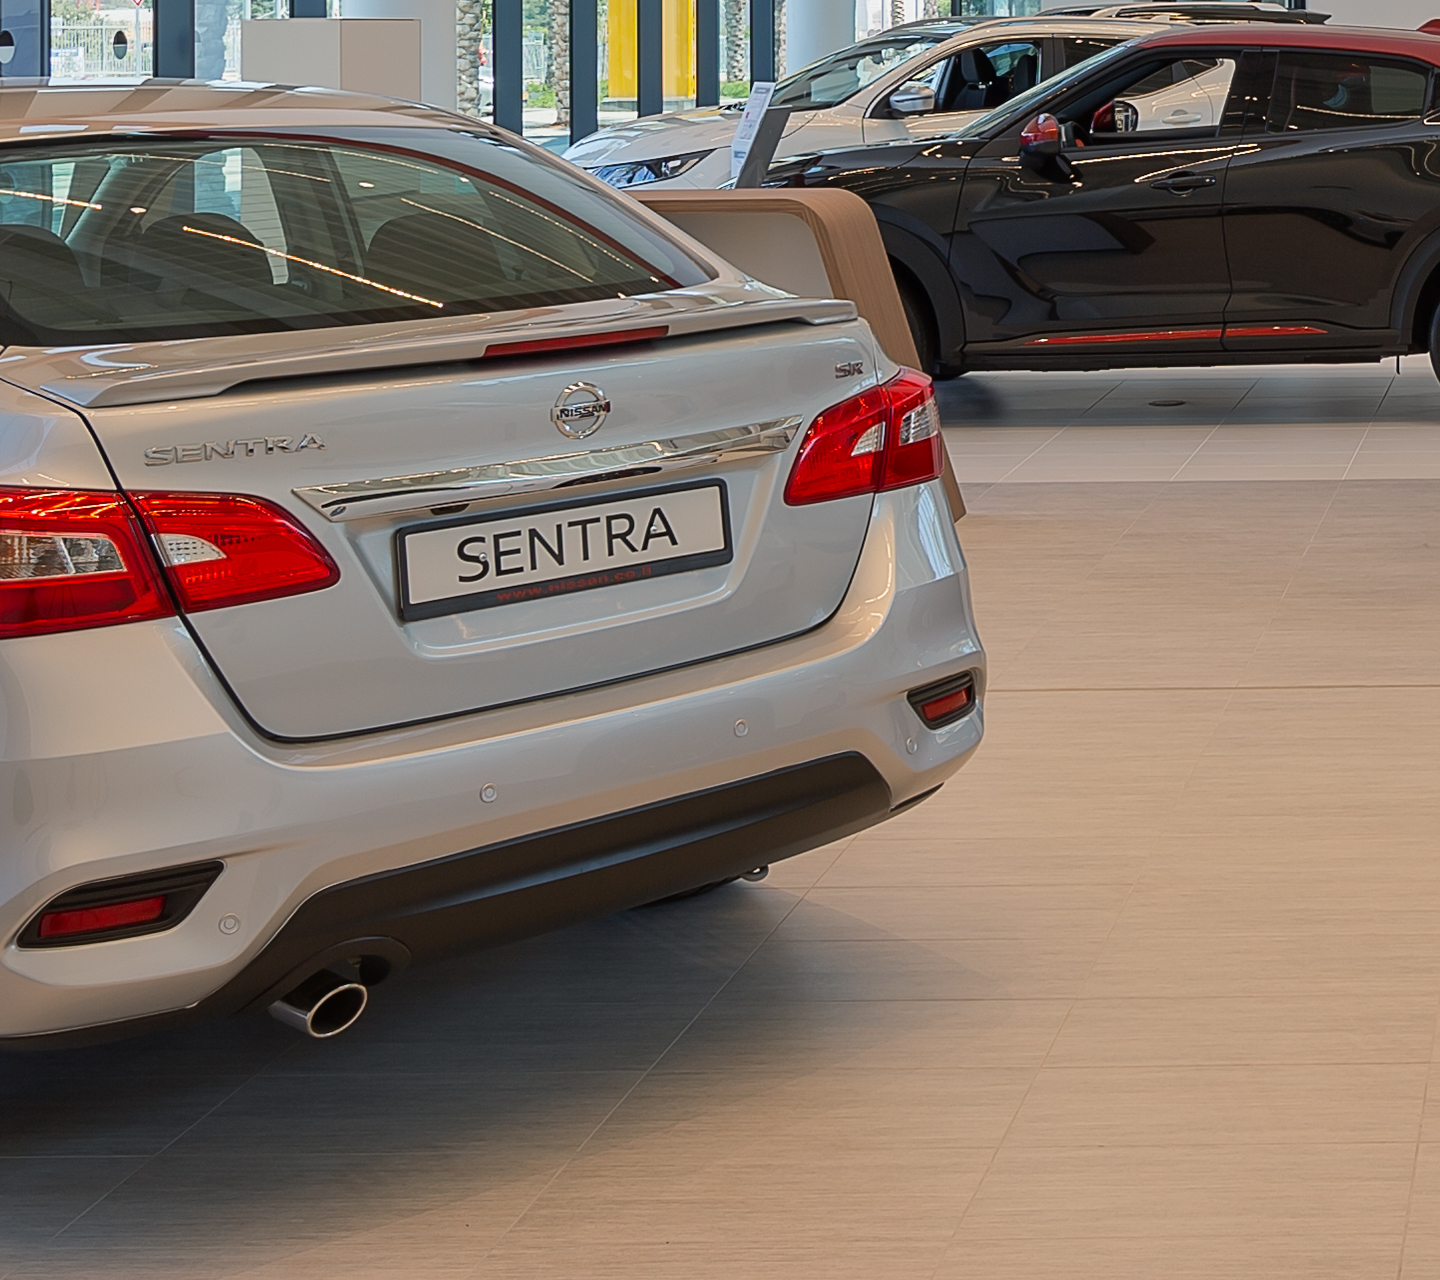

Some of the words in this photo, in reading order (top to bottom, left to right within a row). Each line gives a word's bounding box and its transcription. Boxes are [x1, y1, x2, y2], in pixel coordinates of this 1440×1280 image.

[835, 360, 864, 379] SR
[558, 403, 608, 419] NISSAN
[143, 431, 329, 468] SENTRA
[456, 506, 680, 584] SENTRA
[496, 565, 653, 602] www.nissan.co.il
